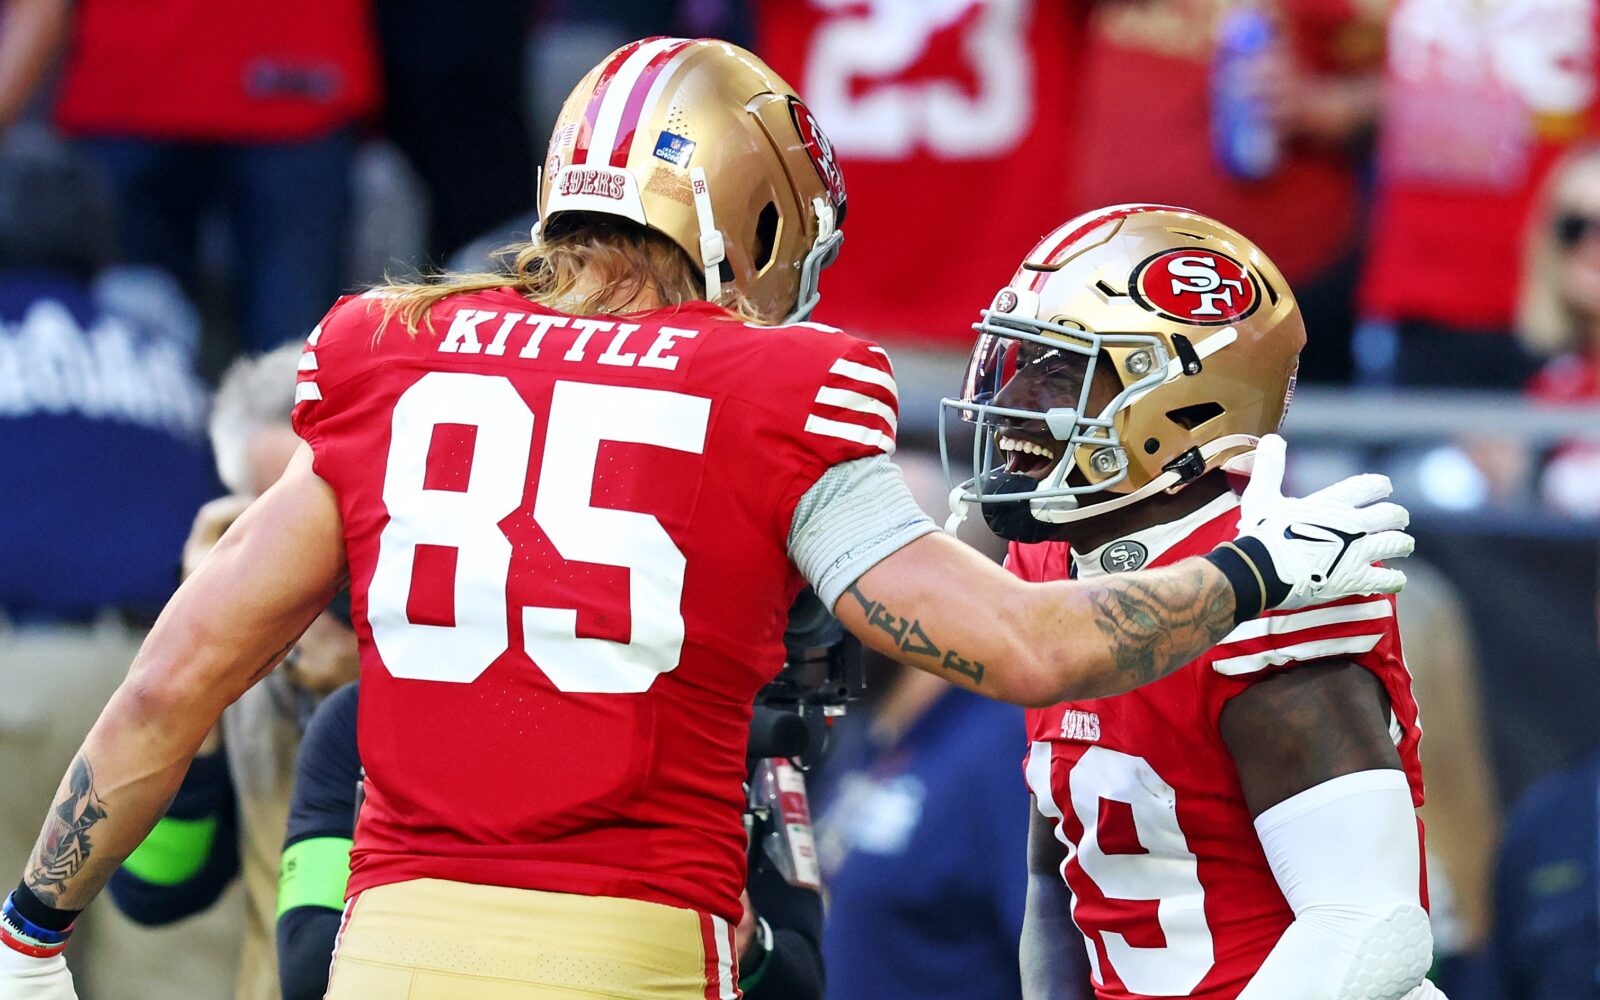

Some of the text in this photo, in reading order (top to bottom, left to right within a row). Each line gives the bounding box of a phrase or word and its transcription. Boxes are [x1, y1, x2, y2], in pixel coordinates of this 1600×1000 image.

[559, 169, 626, 201] 49ERS
[694, 179, 706, 195] 85
[1167, 256, 1244, 315] SF
[437, 308, 699, 371] KITTLE
[367, 371, 712, 693] 85
[1110, 544, 1140, 572] SF
[1060, 709, 1101, 742] 49ERS
[1024, 740, 1215, 997] 19
